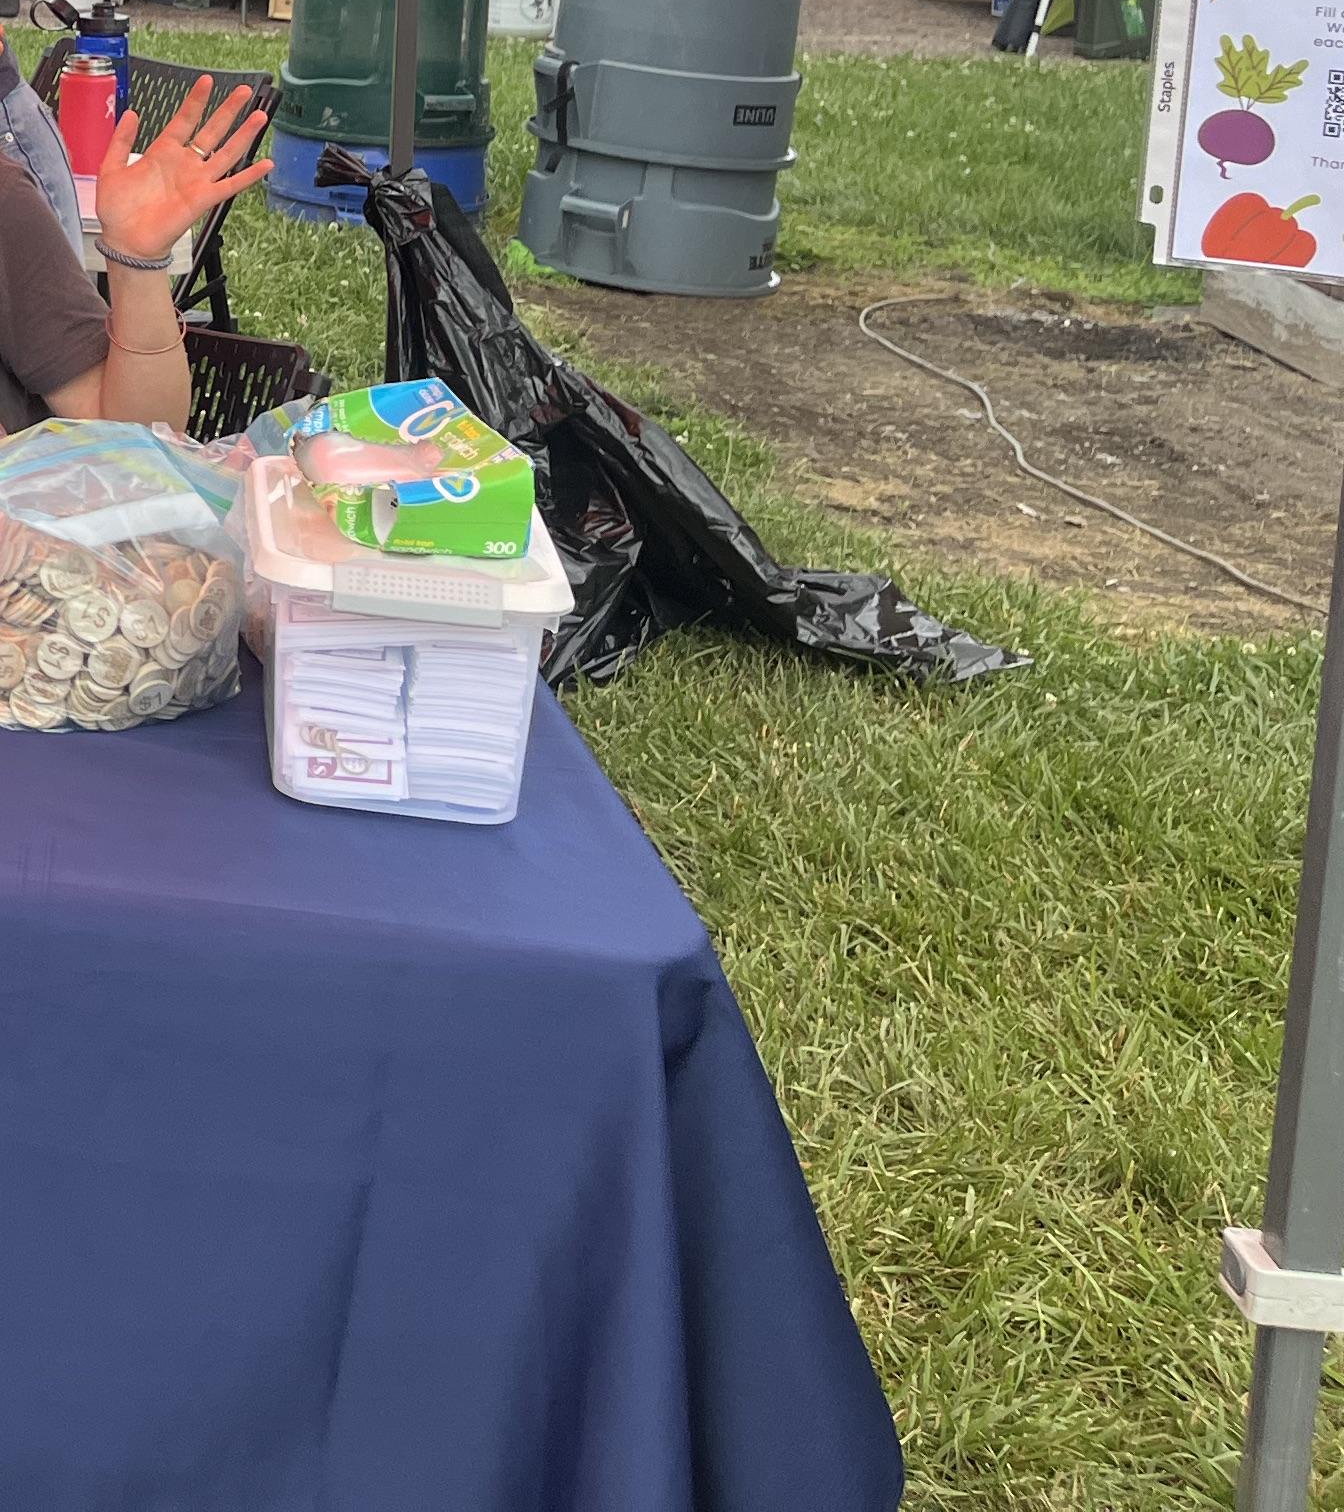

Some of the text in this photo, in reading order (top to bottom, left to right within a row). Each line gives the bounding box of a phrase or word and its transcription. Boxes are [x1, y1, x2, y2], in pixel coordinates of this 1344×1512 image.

[1315, 6, 1337, 18] Fill
[1313, 37, 1344, 49] eac
[1157, 60, 1176, 113] Staples
[481, 541, 517, 555] 300
[137, 690, 163, 712] $1
